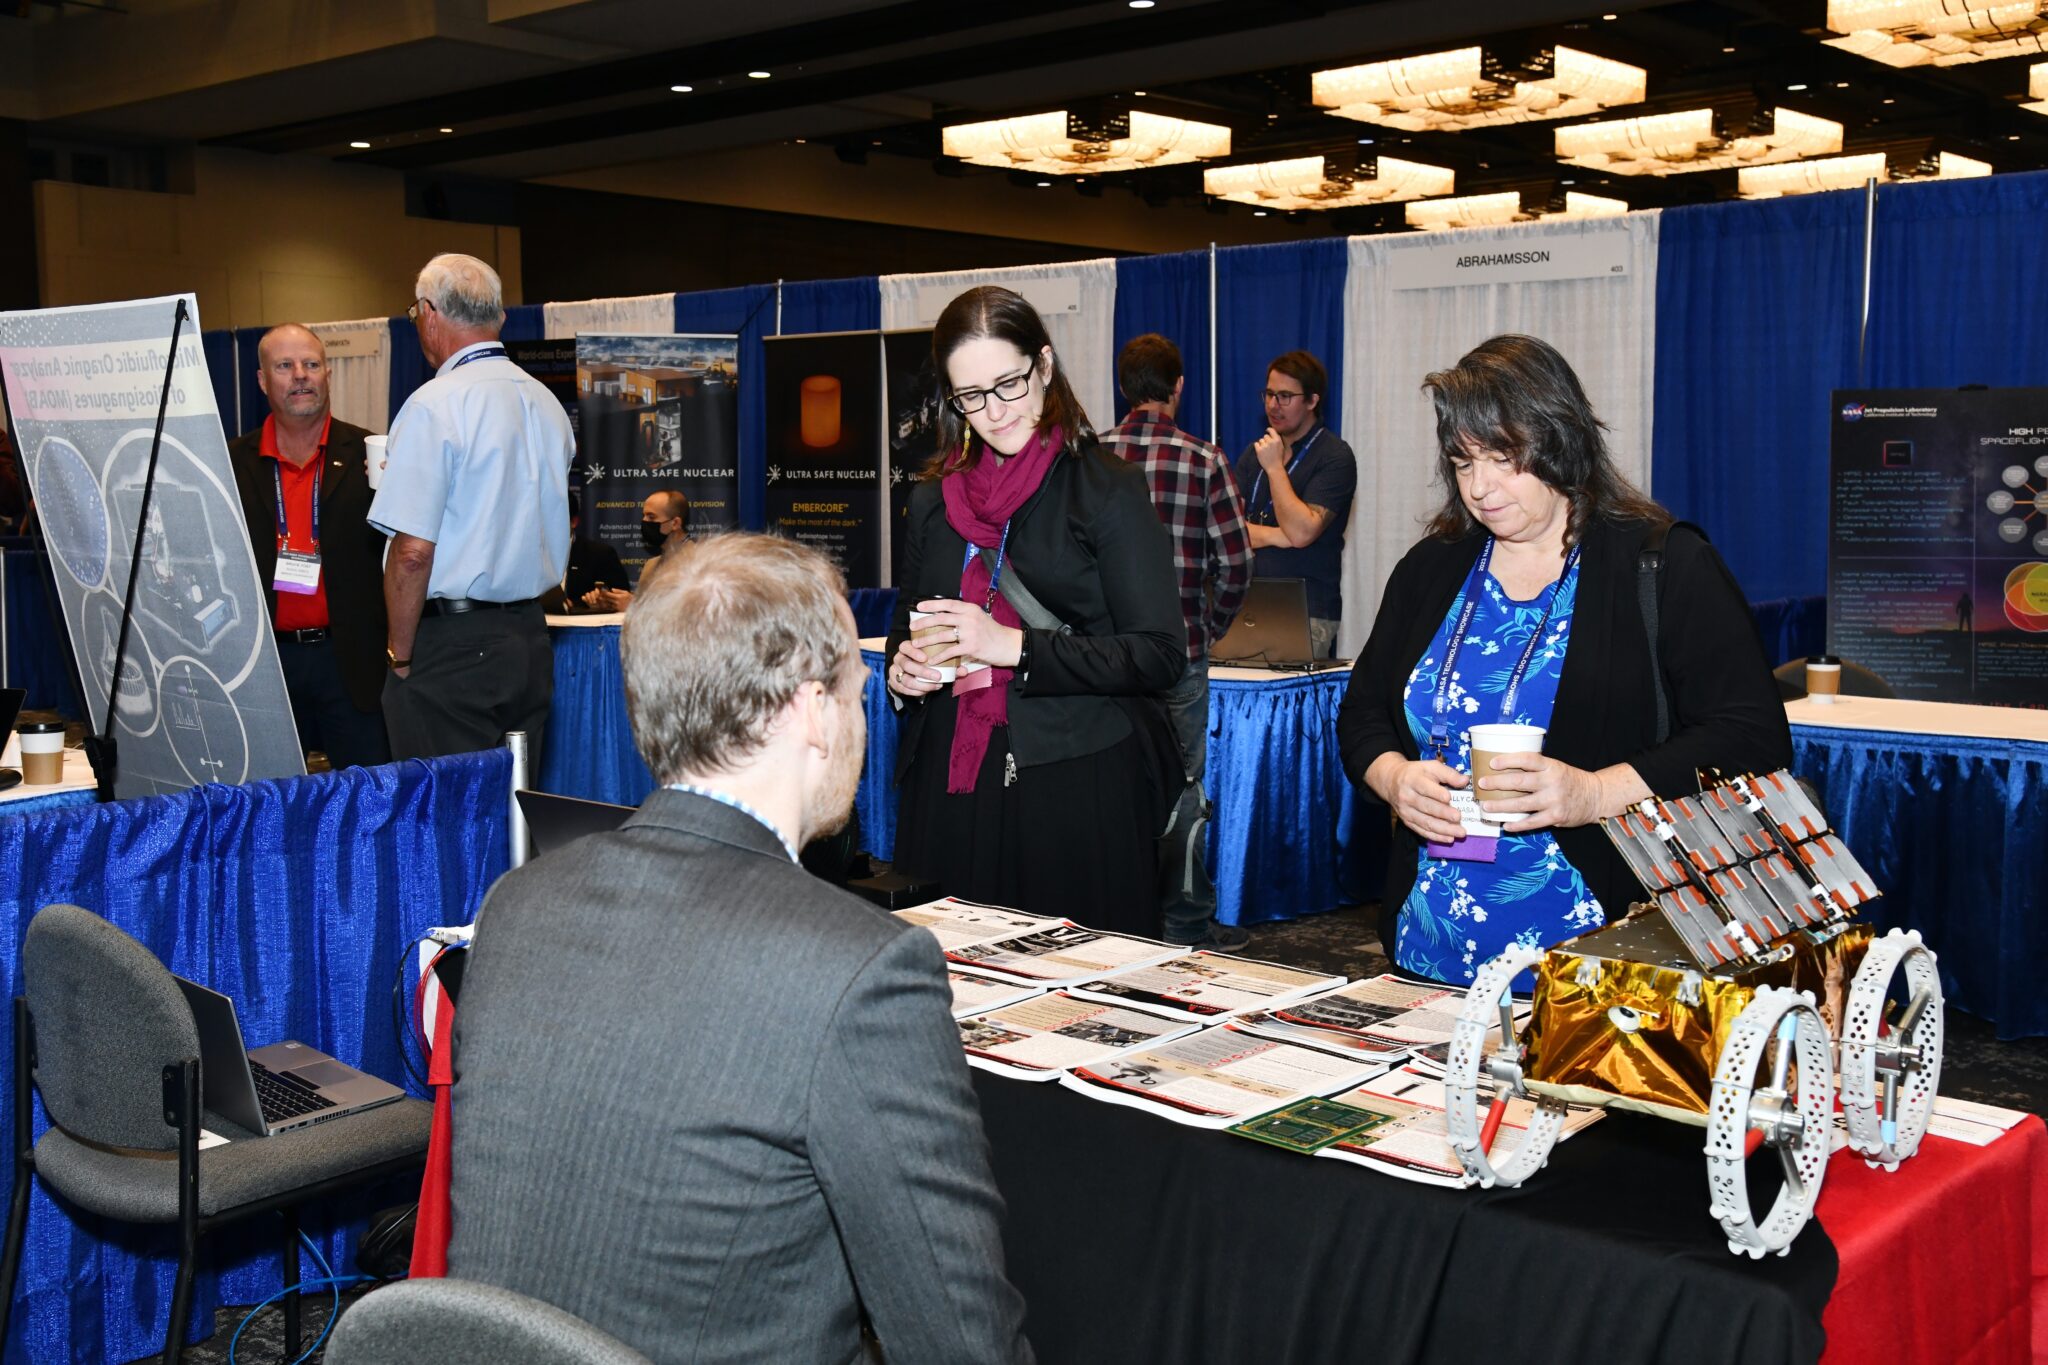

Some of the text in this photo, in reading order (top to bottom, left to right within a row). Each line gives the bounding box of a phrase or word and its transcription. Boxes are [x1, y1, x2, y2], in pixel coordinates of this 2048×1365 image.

[1456, 251, 1550, 268] ABRAHAMSSON
[1610, 265, 1623, 273] 403
[518, 350, 554, 360] World-class
[613, 469, 734, 478] ULTRA SAFE NUCLEAR
[786, 470, 876, 479] ULTRA SAFE NUCLEAR
[596, 501, 636, 509] ADVANCED
[693, 501, 725, 509] DIVISION
[1478, 541, 1492, 571] 2023 NASA
[1436, 601, 1474, 714] 2023 NASA TECHNOLOGY SHOWCASE
[1503, 674, 1520, 716] SHOWCASE
